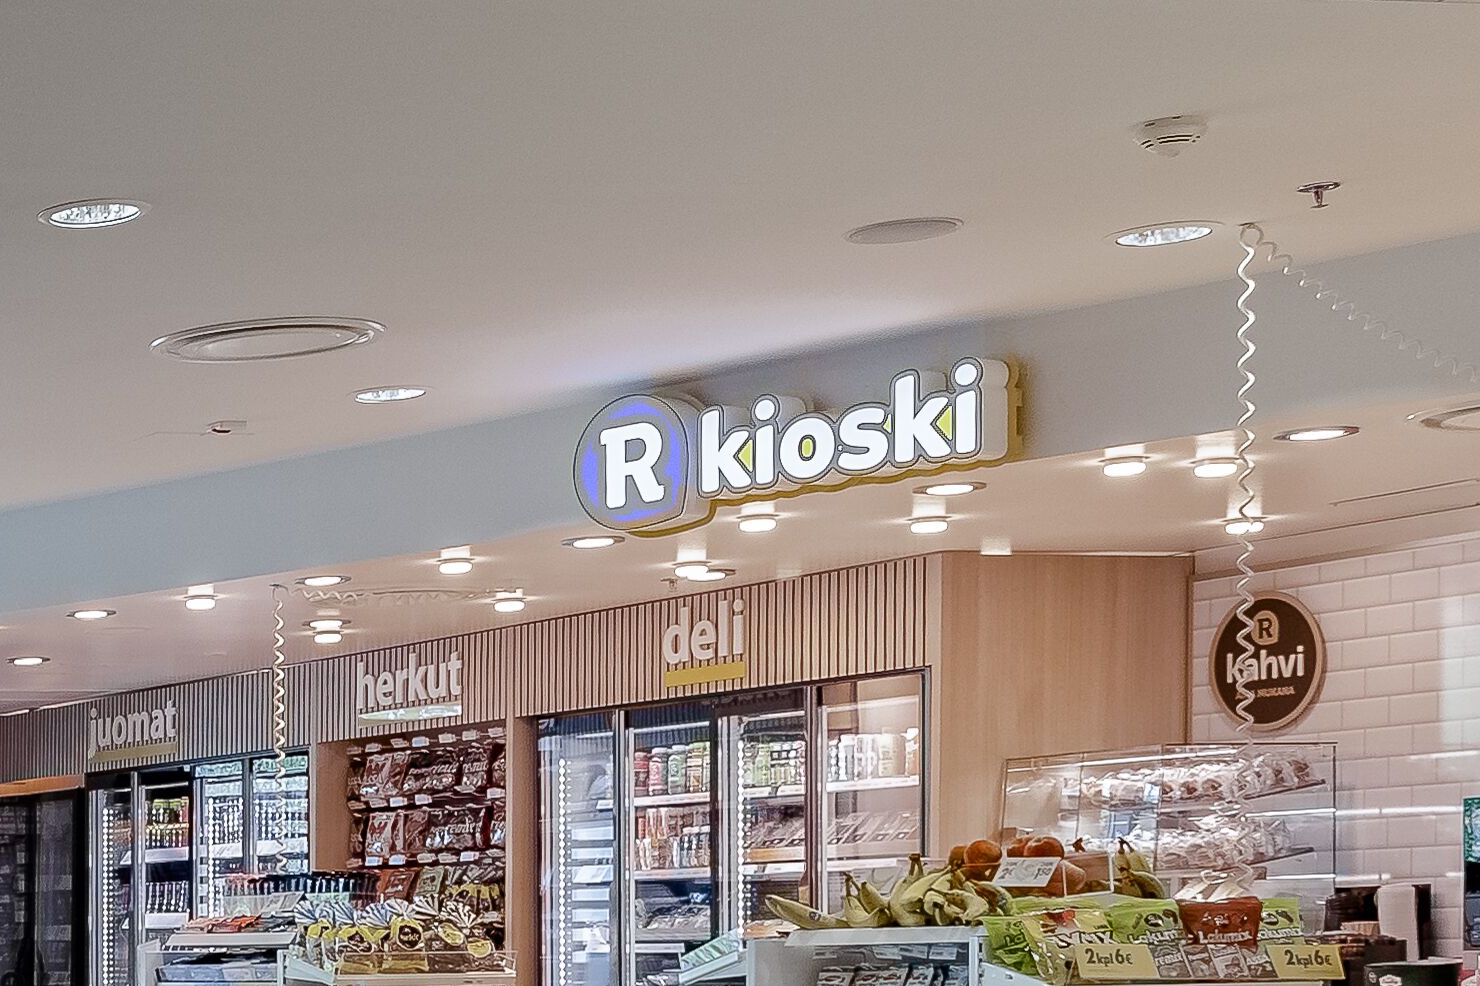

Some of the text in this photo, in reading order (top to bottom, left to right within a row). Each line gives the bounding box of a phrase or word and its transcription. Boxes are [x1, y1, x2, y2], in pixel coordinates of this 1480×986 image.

[600, 362, 980, 510] R kioski
[662, 599, 745, 664] deli
[1256, 617, 1273, 639] R
[357, 651, 463, 709] herkut
[1226, 645, 1305, 684] kahvi
[87, 699, 178, 760] juomat
